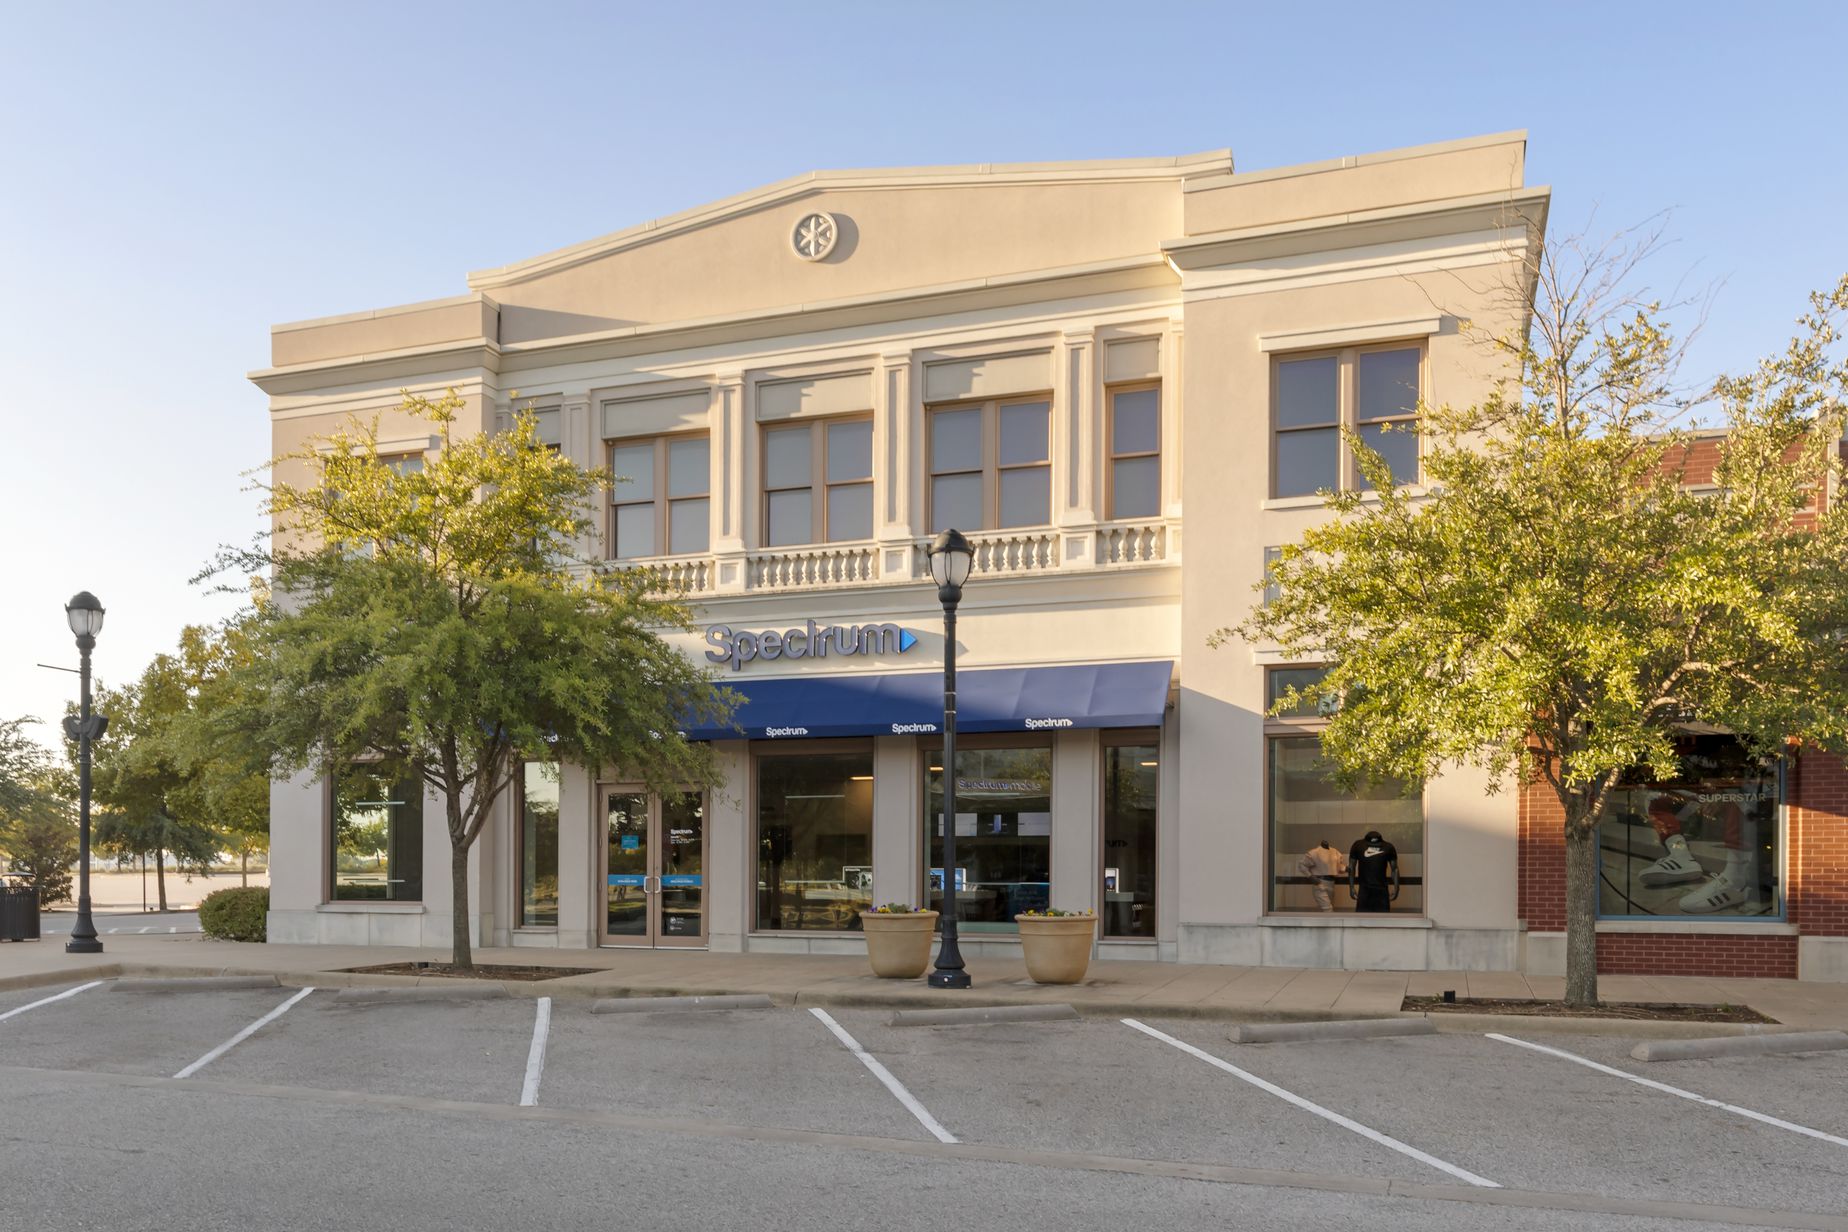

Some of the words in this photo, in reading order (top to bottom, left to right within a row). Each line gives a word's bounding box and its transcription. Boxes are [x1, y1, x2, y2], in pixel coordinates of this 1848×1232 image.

[705, 619, 901, 671] Spectrum
[892, 723, 932, 734] Spectrum
[1025, 717, 1067, 729] Spectrum
[766, 727, 804, 738] Spectrum
[1698, 793, 1766, 803] SUPERSTAR
